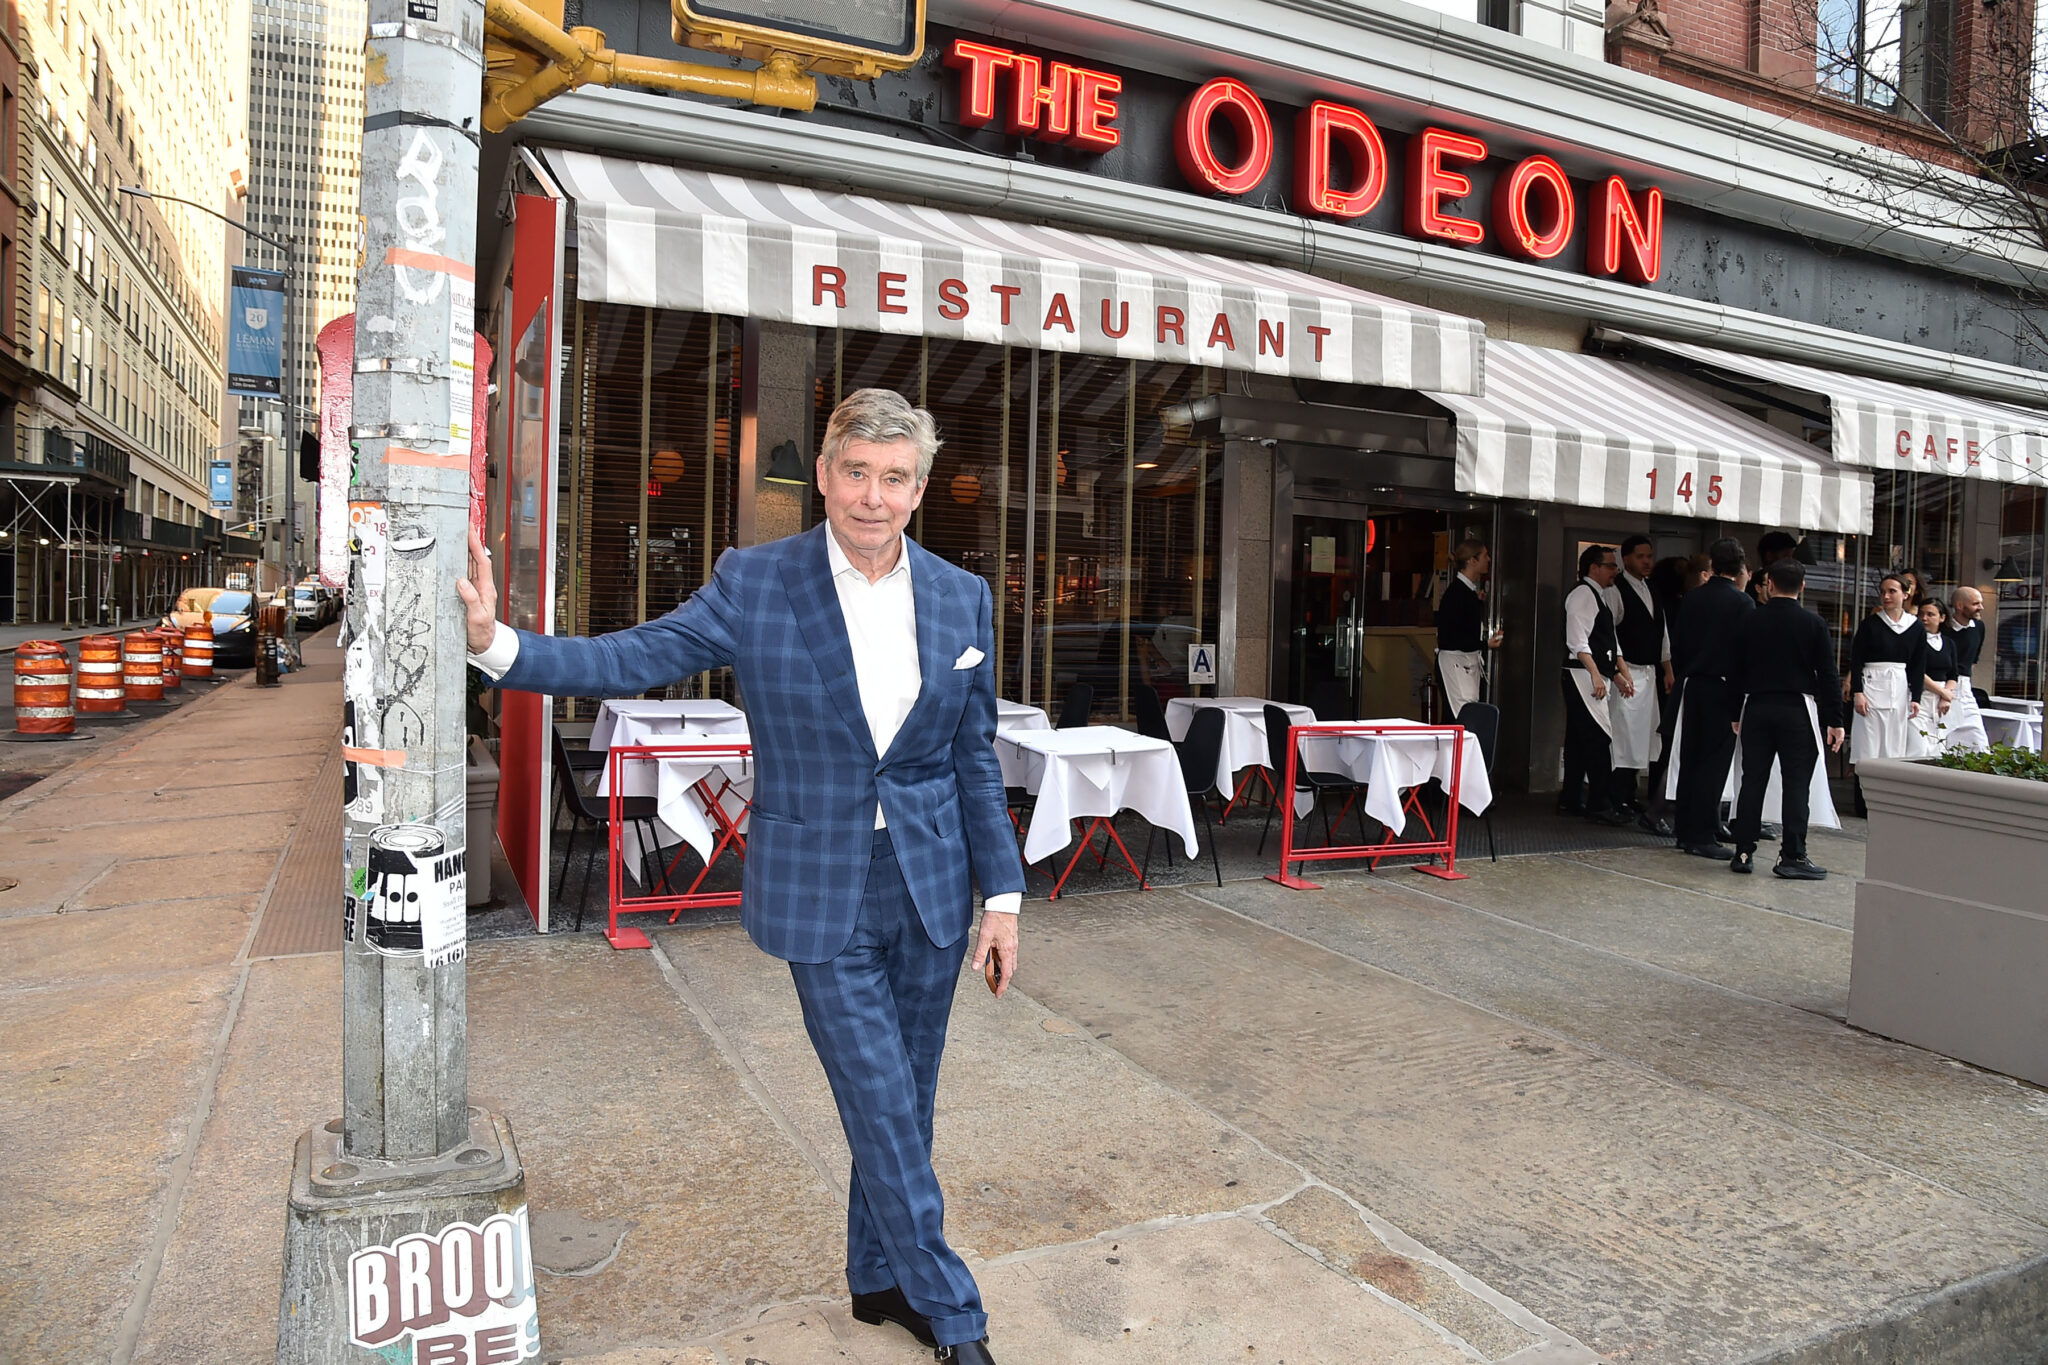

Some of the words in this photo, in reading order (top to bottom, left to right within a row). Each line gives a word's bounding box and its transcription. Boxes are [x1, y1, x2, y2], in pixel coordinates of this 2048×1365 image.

[943, 39, 1123, 154] THE
[1174, 76, 1663, 284] ODEON
[249, 313, 264, 322] 20
[812, 264, 1331, 362] RESTAURANT
[1896, 430, 1981, 466] CAFE
[1646, 467, 1723, 507] 145
[1193, 648, 1212, 673] A
